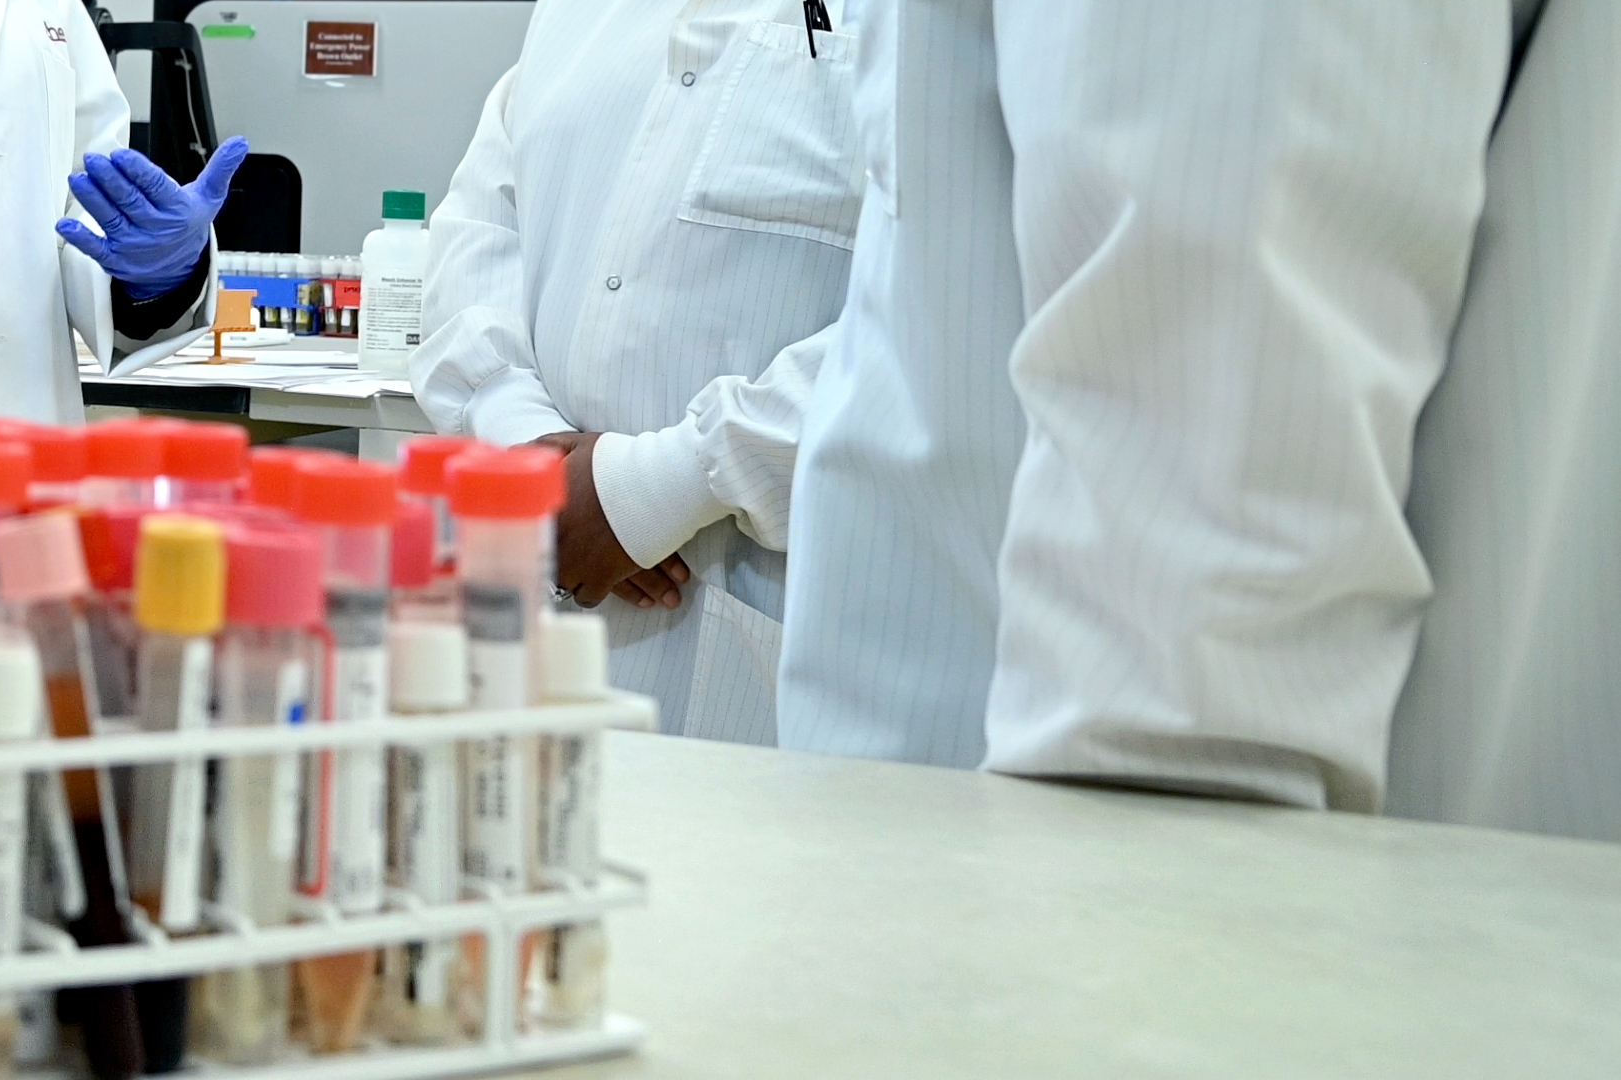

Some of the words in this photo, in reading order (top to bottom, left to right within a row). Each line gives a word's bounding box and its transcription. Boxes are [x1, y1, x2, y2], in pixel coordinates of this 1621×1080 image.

[318, 32, 354, 40] Connected
[309, 42, 347, 52] Emergency
[348, 43, 371, 51] Power
[316, 52, 339, 60] Brown
